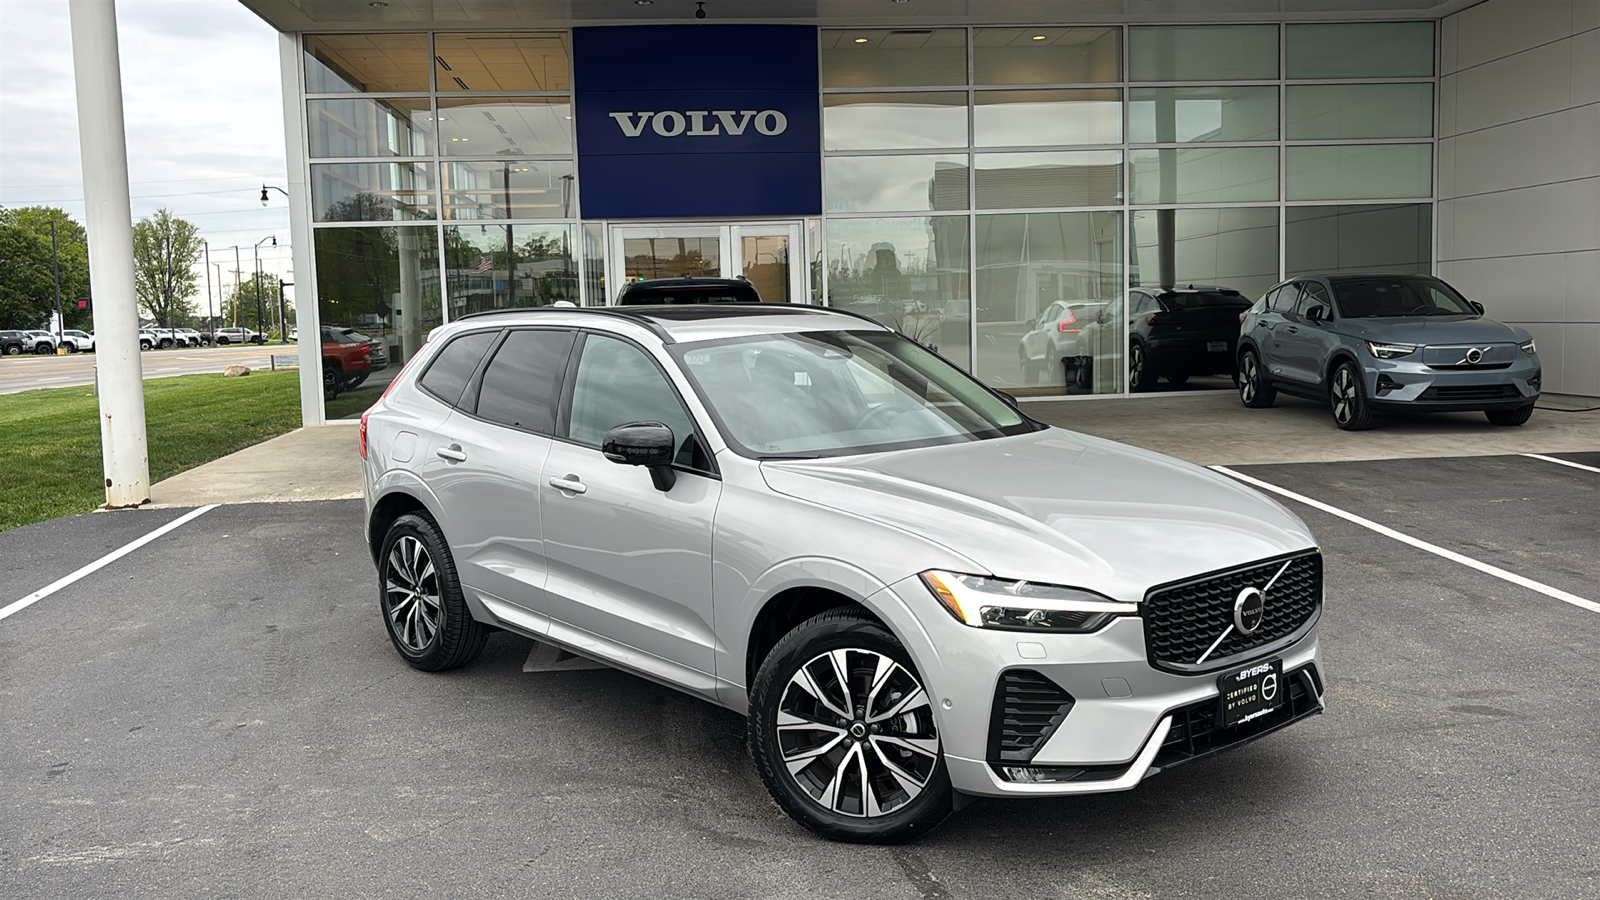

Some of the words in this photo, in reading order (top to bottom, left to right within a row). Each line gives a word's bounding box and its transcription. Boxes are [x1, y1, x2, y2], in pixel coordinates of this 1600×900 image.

[608, 109, 788, 137] VOLVO
[1240, 663, 1268, 680] BYERS
[1226, 683, 1258, 700] CERTIFIED
[1228, 702, 1236, 710] BY
[1237, 694, 1257, 706] VOLVO
